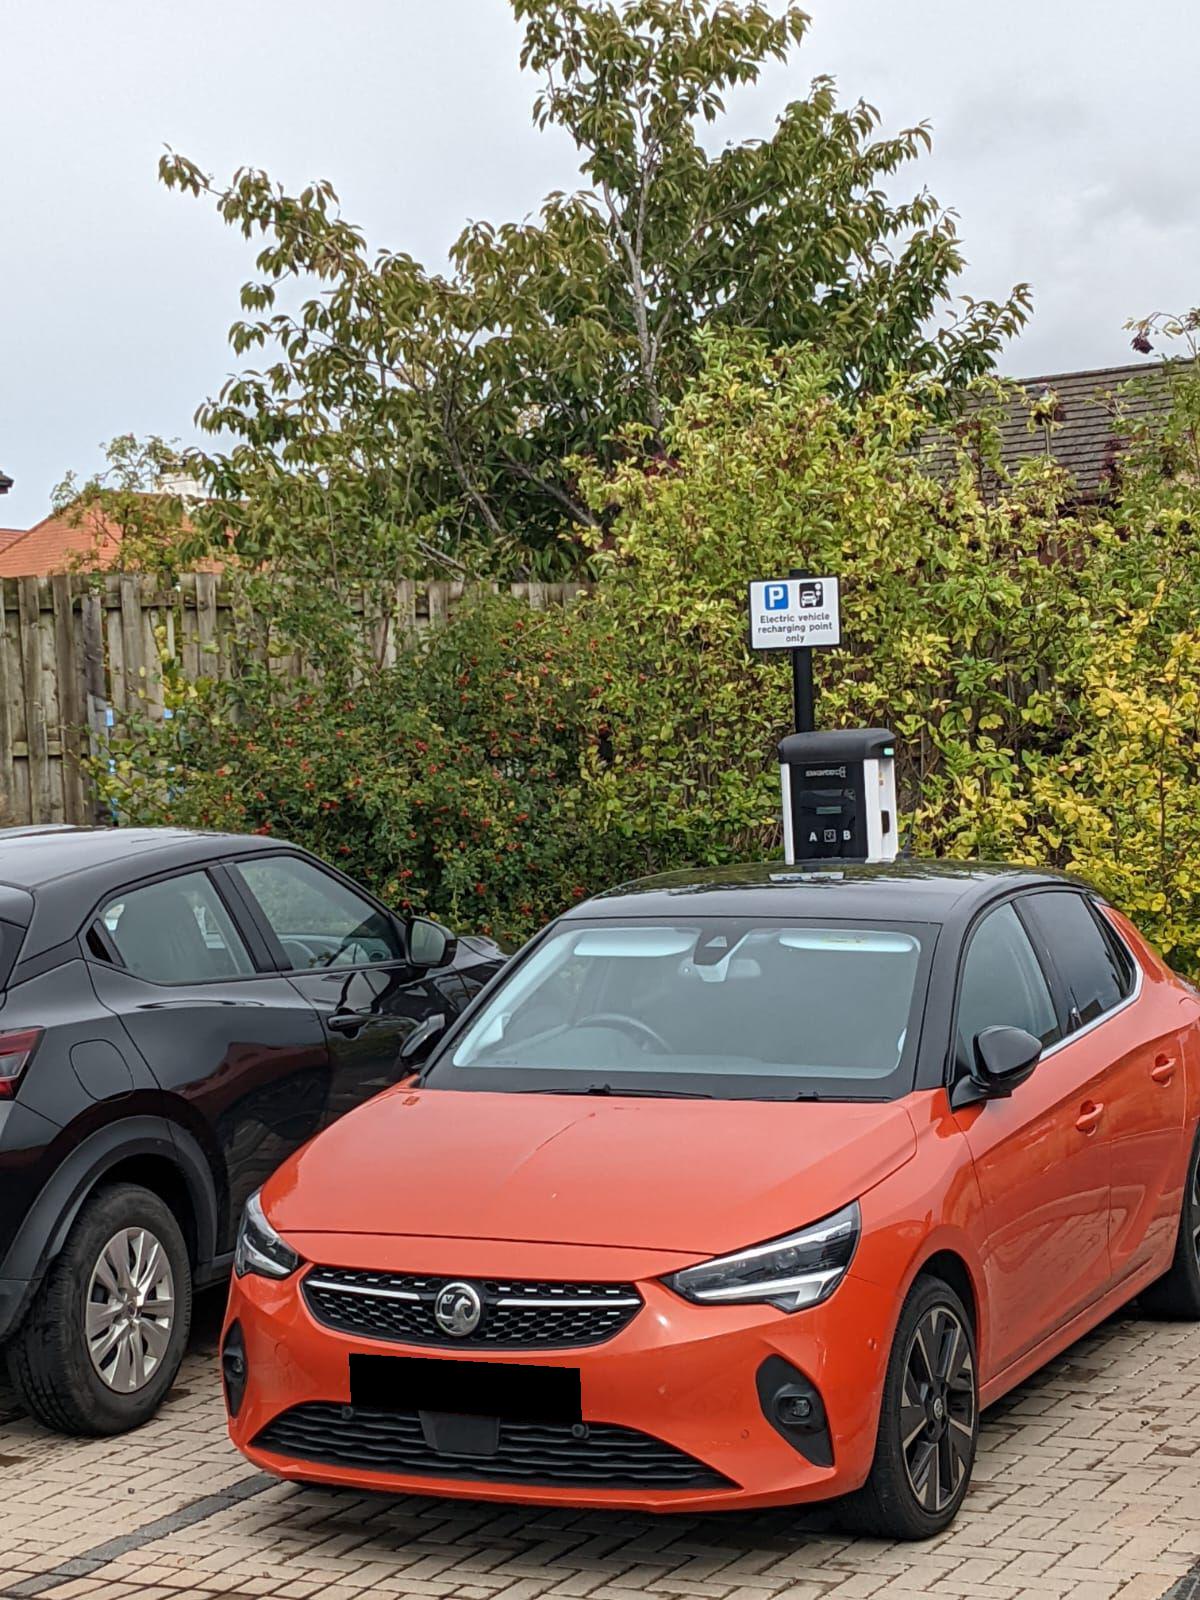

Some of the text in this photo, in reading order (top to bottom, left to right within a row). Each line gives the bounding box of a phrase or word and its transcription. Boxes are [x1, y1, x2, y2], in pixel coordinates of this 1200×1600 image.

[769, 587, 783, 607] P
[760, 612, 830, 623] Electric vehicle
[758, 622, 832, 633] recharging point
[786, 634, 805, 643] only
[809, 830, 851, 842] A B
